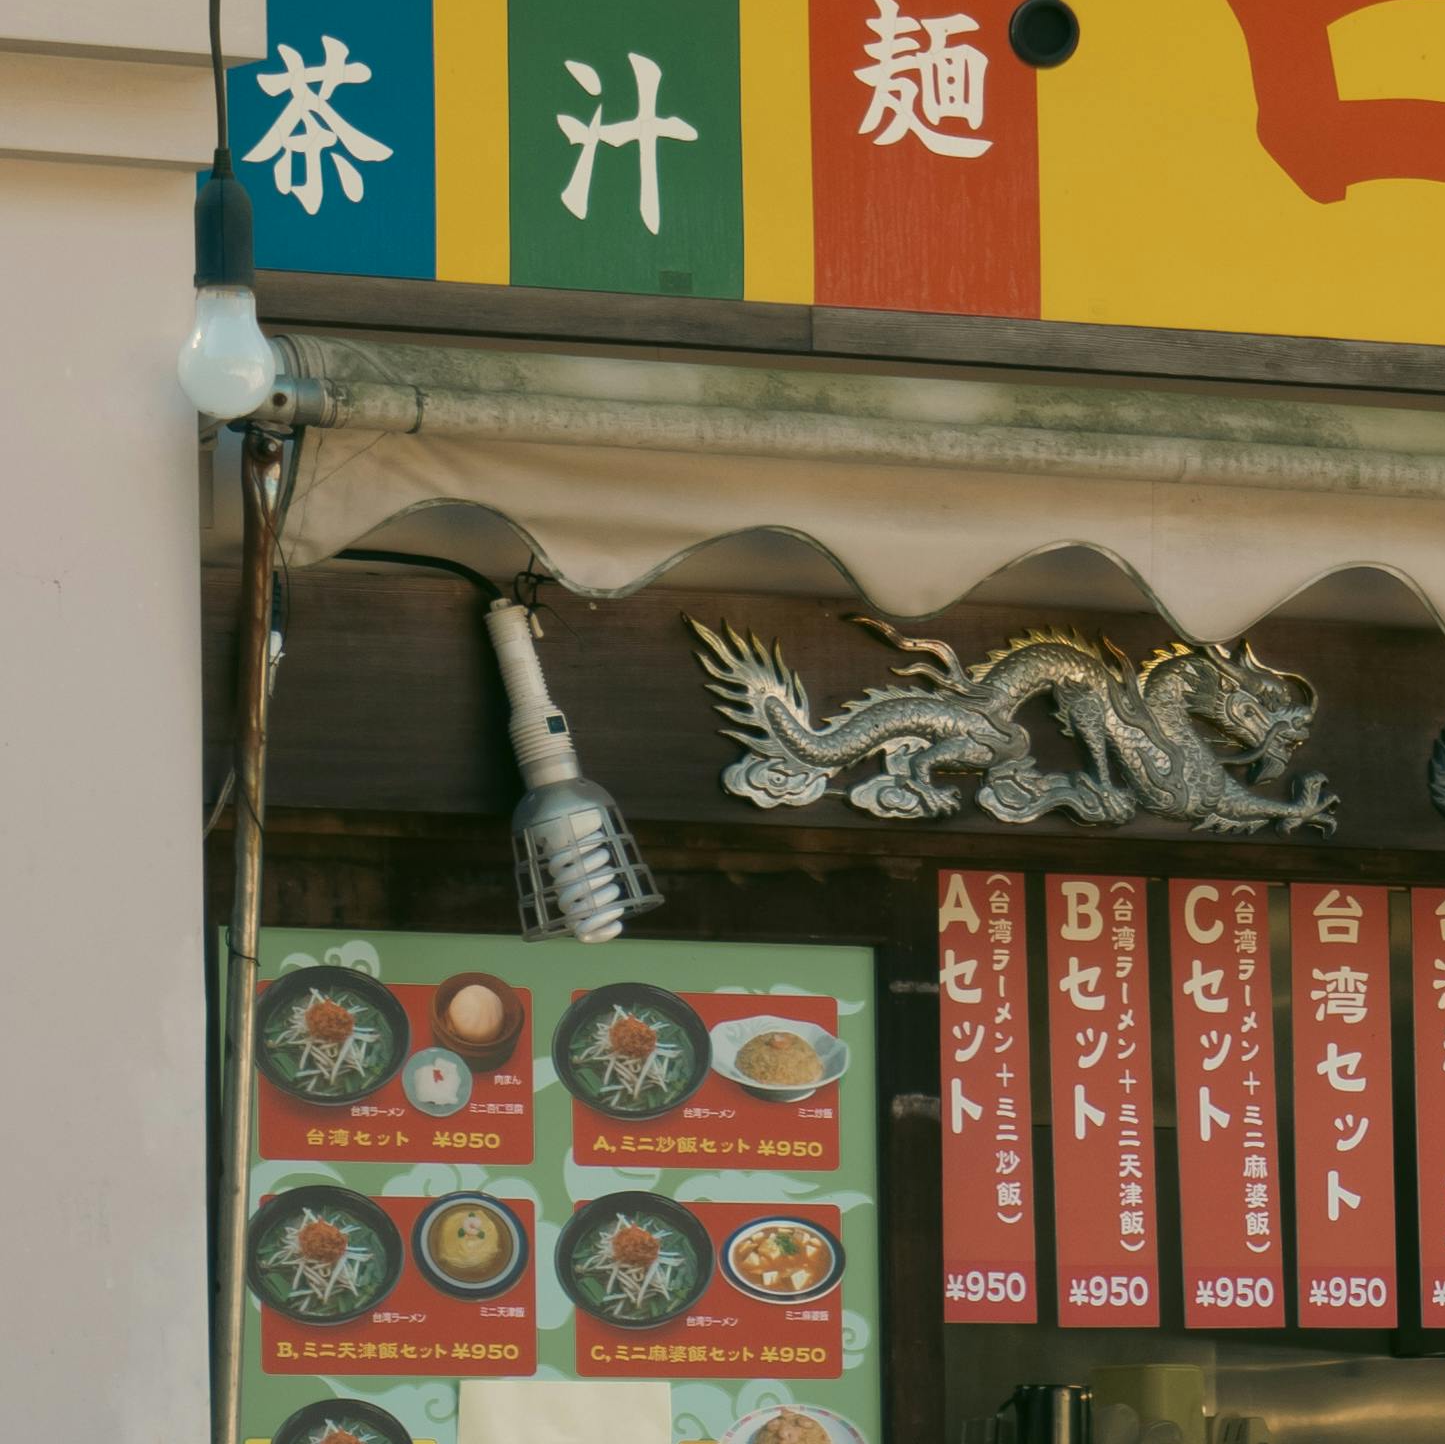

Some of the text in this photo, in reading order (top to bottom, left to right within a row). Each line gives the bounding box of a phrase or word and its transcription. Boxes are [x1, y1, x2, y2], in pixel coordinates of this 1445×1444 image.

[938, 873, 987, 1134] Aセット
[1059, 881, 1108, 1140] Bセット
[1183, 885, 1232, 1142] Cセット
[1310, 889, 1370, 1221] 台湾セット
[351, 1106, 405, 1117] 台湾ラーメン
[306, 1128, 501, 1149] 台湾セット ¥950
[757, 1140, 823, 1157] ¥950
[945, 1272, 1026, 1303] ¥950
[1069, 1276, 1149, 1307] ¥950
[1195, 1277, 1274, 1308] ¥950
[1309, 1278, 1387, 1308] ¥950
[372, 1312, 426, 1324] 台湾ラーメン
[686, 1315, 739, 1327] 台湾ラーメン
[451, 1344, 519, 1360] ¥950
[760, 1346, 826, 1364] ¥950
